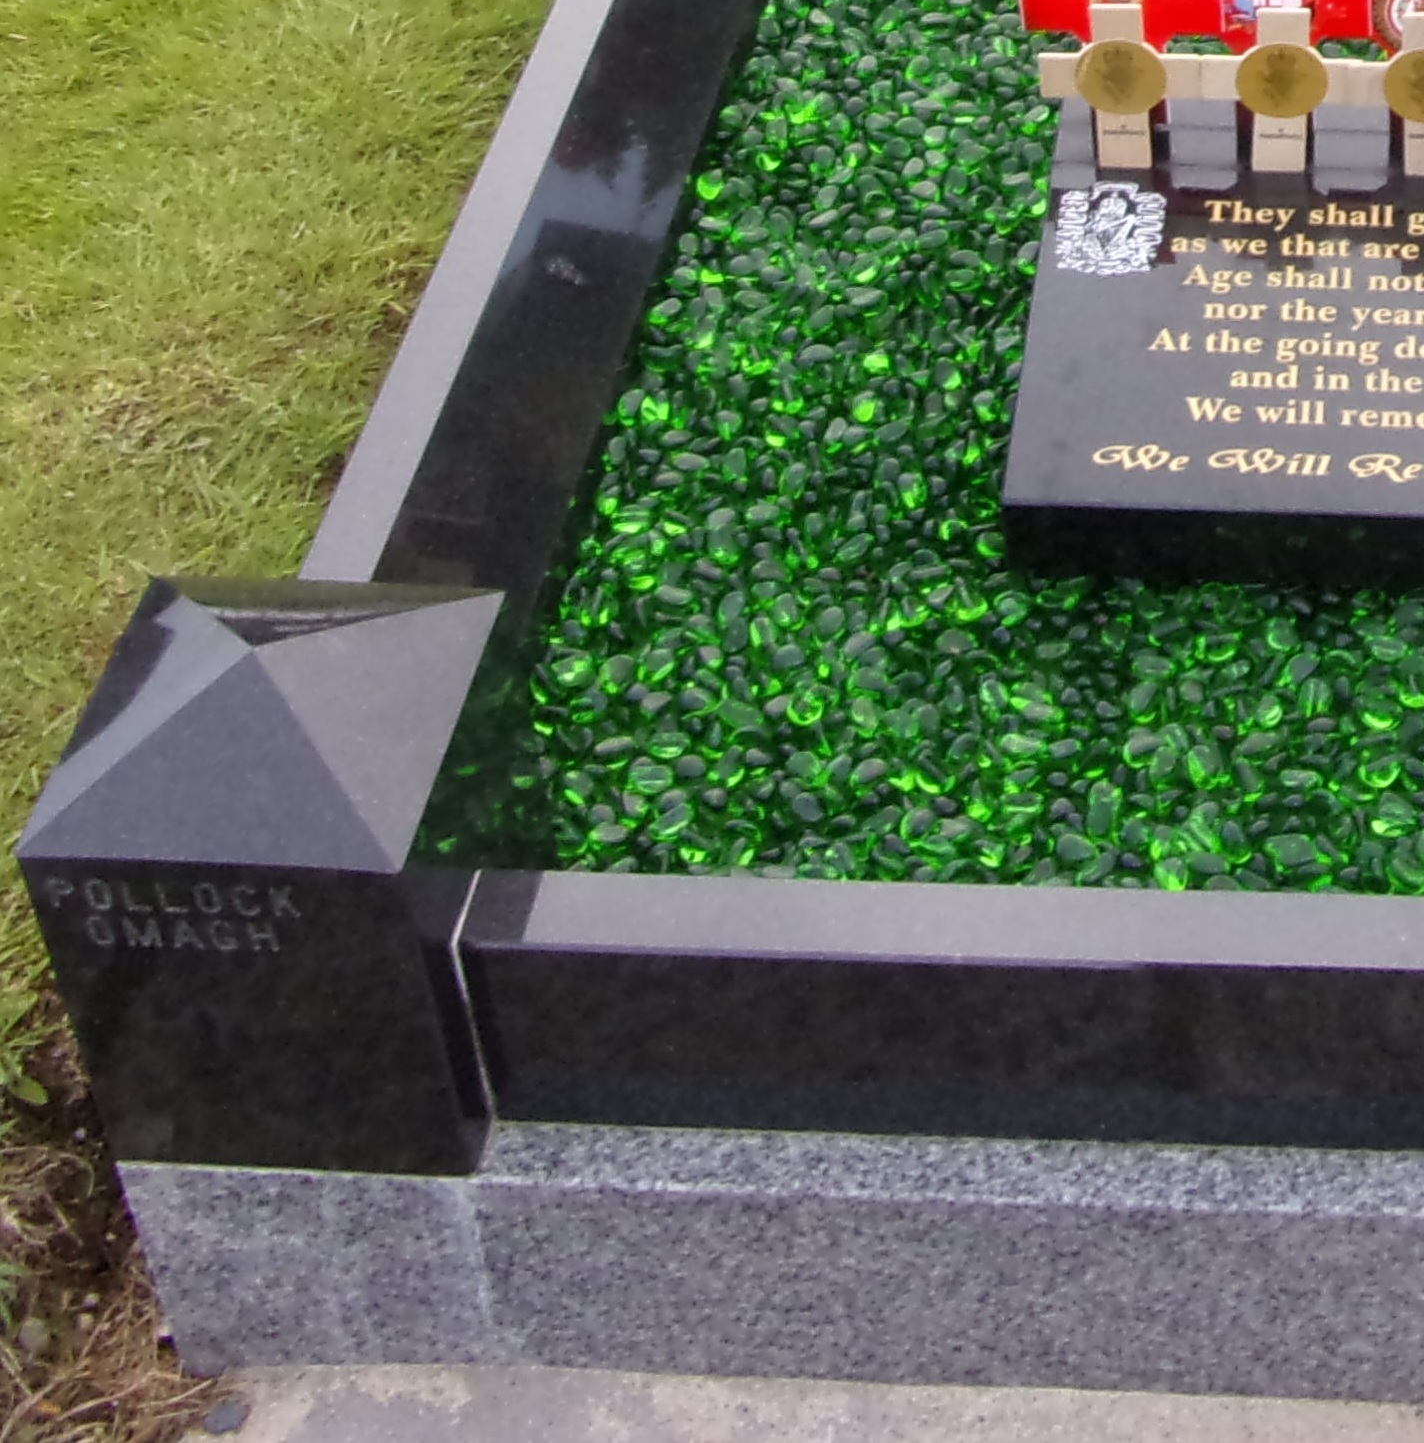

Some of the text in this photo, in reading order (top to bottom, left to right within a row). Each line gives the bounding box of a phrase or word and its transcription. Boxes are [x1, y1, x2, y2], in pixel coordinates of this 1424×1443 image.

[1206, 202, 1295, 230] They
[1309, 203, 1393, 227] shall
[1172, 238, 1206, 253] as
[1222, 240, 1266, 255] we
[1282, 235, 1350, 256] that
[1362, 244, 1419, 260] are
[1183, 264, 1252, 293] Age
[1267, 266, 1351, 289] shall
[1368, 275, 1424, 292] not
[1204, 304, 1267, 320] nor
[1281, 298, 1336, 322] the
[1149, 328, 1191, 351] At
[1206, 330, 1262, 353] the
[1276, 333, 1380, 365] going
[1230, 365, 1298, 388] and
[1314, 366, 1348, 390] in
[1366, 369, 1422, 393] the
[1186, 397, 1241, 422] We
[1256, 399, 1324, 424] will
[1093, 445, 1189, 471] We
[1208, 448, 1330, 476] Will
[47, 878, 301, 918] POLLOCK
[86, 915, 281, 952] OMAGH
